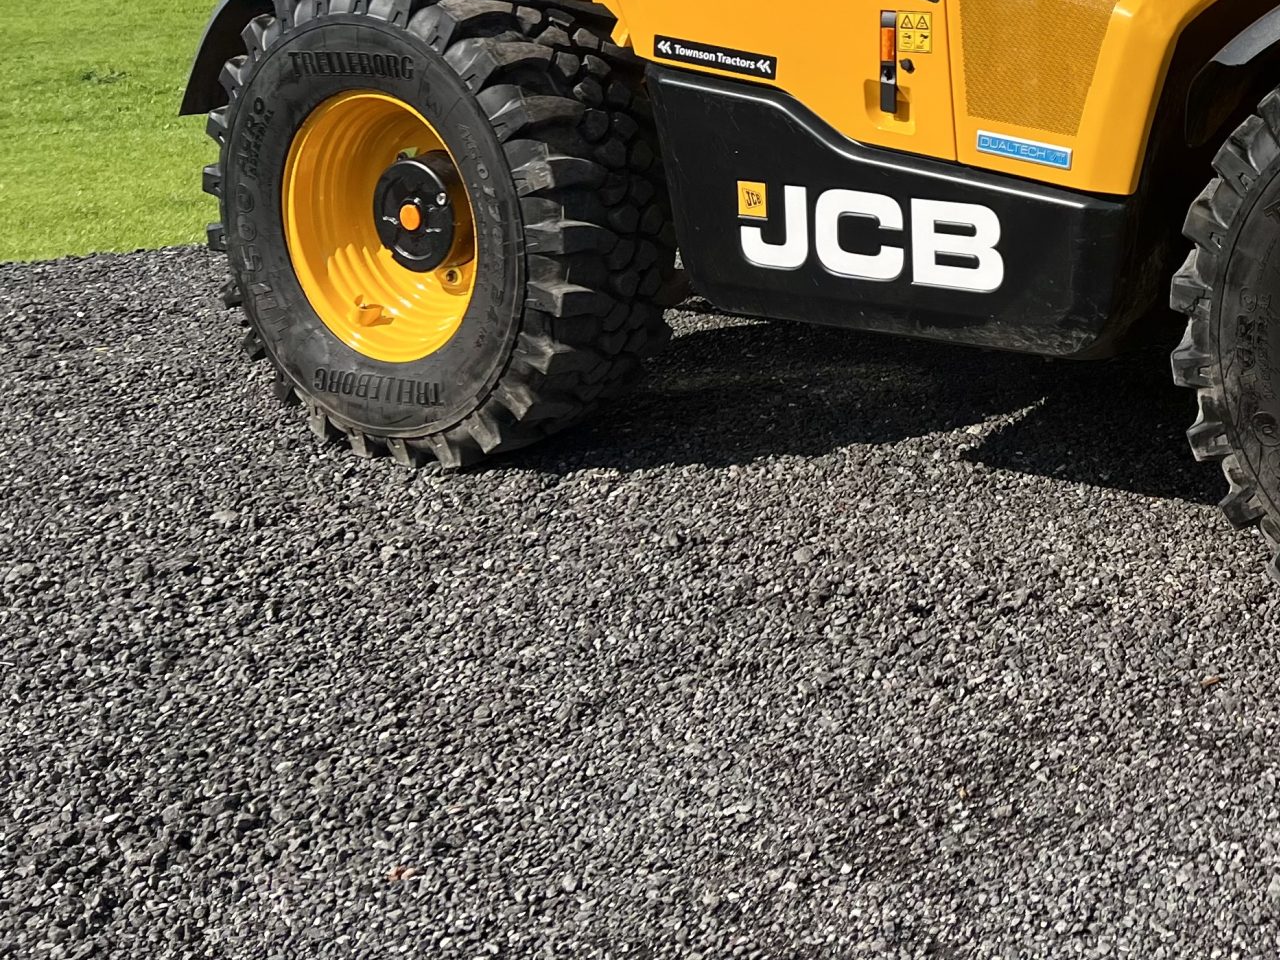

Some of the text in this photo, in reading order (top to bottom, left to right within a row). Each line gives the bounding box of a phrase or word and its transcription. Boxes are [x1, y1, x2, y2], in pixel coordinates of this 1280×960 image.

[288, 51, 414, 81] TRELLEBORG
[674, 44, 755, 69] Townson Tractors
[980, 136, 1046, 159] DUALTECH
[745, 190, 762, 207] JCB
[740, 184, 1004, 294] JCB
[313, 368, 446, 408] TRELLEBORG
